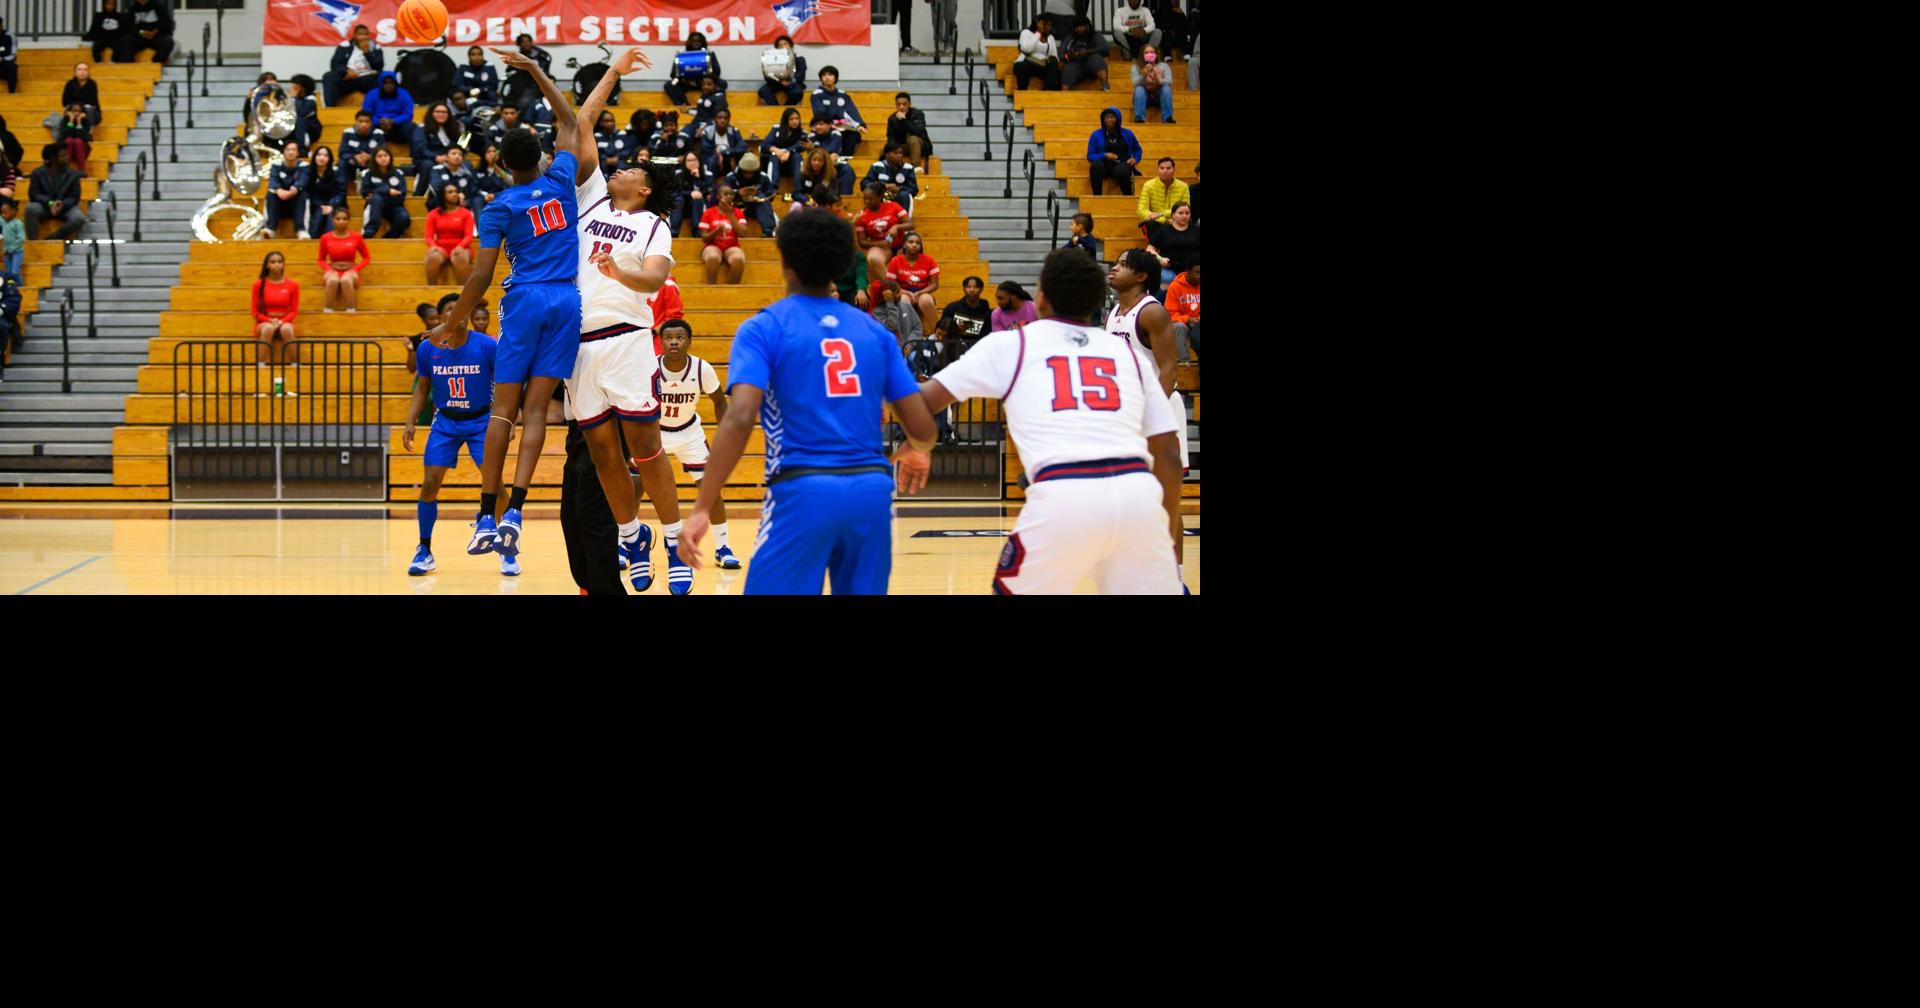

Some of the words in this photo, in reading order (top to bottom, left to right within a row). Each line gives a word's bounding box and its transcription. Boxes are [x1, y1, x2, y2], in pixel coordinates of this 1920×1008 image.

[377, 16, 561, 44] SDENT
[579, 16, 756, 43] SECTION
[527, 198, 567, 237] 10
[584, 219, 637, 243] PATRIOTS
[432, 365, 481, 375] PEACHTREE
[821, 338, 862, 398] 2
[448, 377, 467, 398] 11
[1048, 355, 1122, 412] 15
[661, 393, 696, 404] TRIOTS
[664, 405, 680, 418] 11
